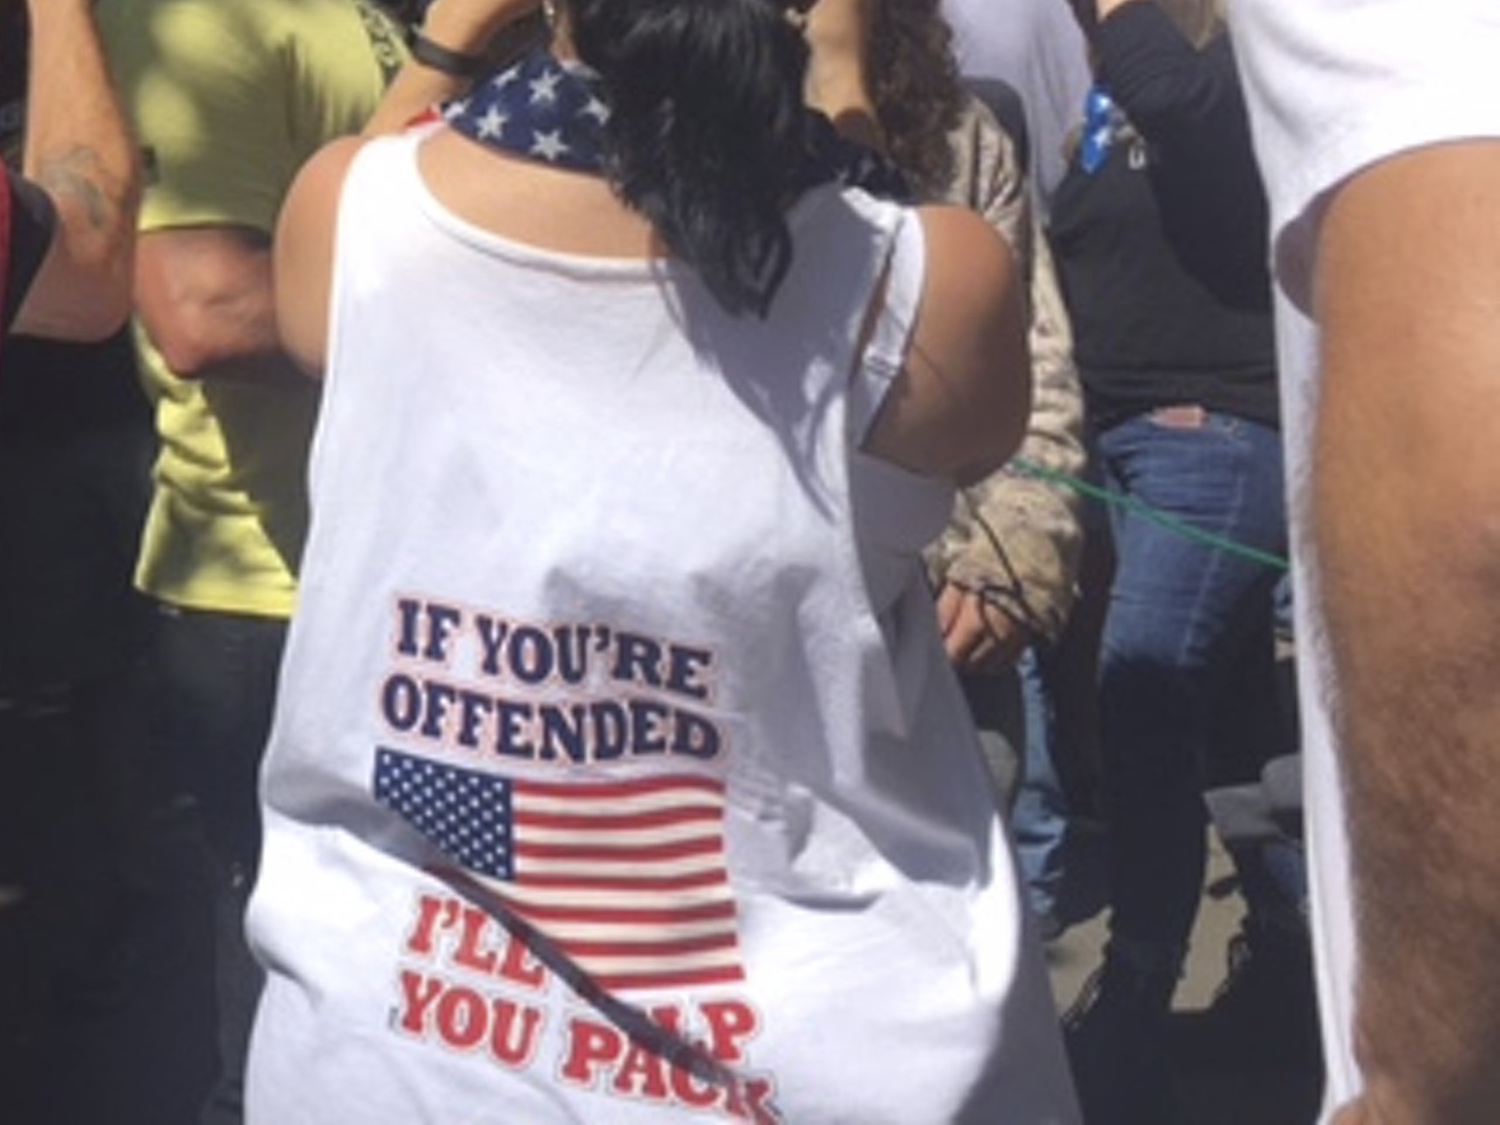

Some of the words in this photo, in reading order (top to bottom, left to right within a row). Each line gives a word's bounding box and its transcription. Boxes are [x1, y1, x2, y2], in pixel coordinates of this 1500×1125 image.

[397, 598, 460, 662] IF
[474, 614, 713, 700] YOU'RE
[381, 674, 722, 763] OFFENDED
[407, 893, 546, 990] I'LL
[399, 968, 541, 1066] YOU
[562, 1017, 775, 1125] PACK
